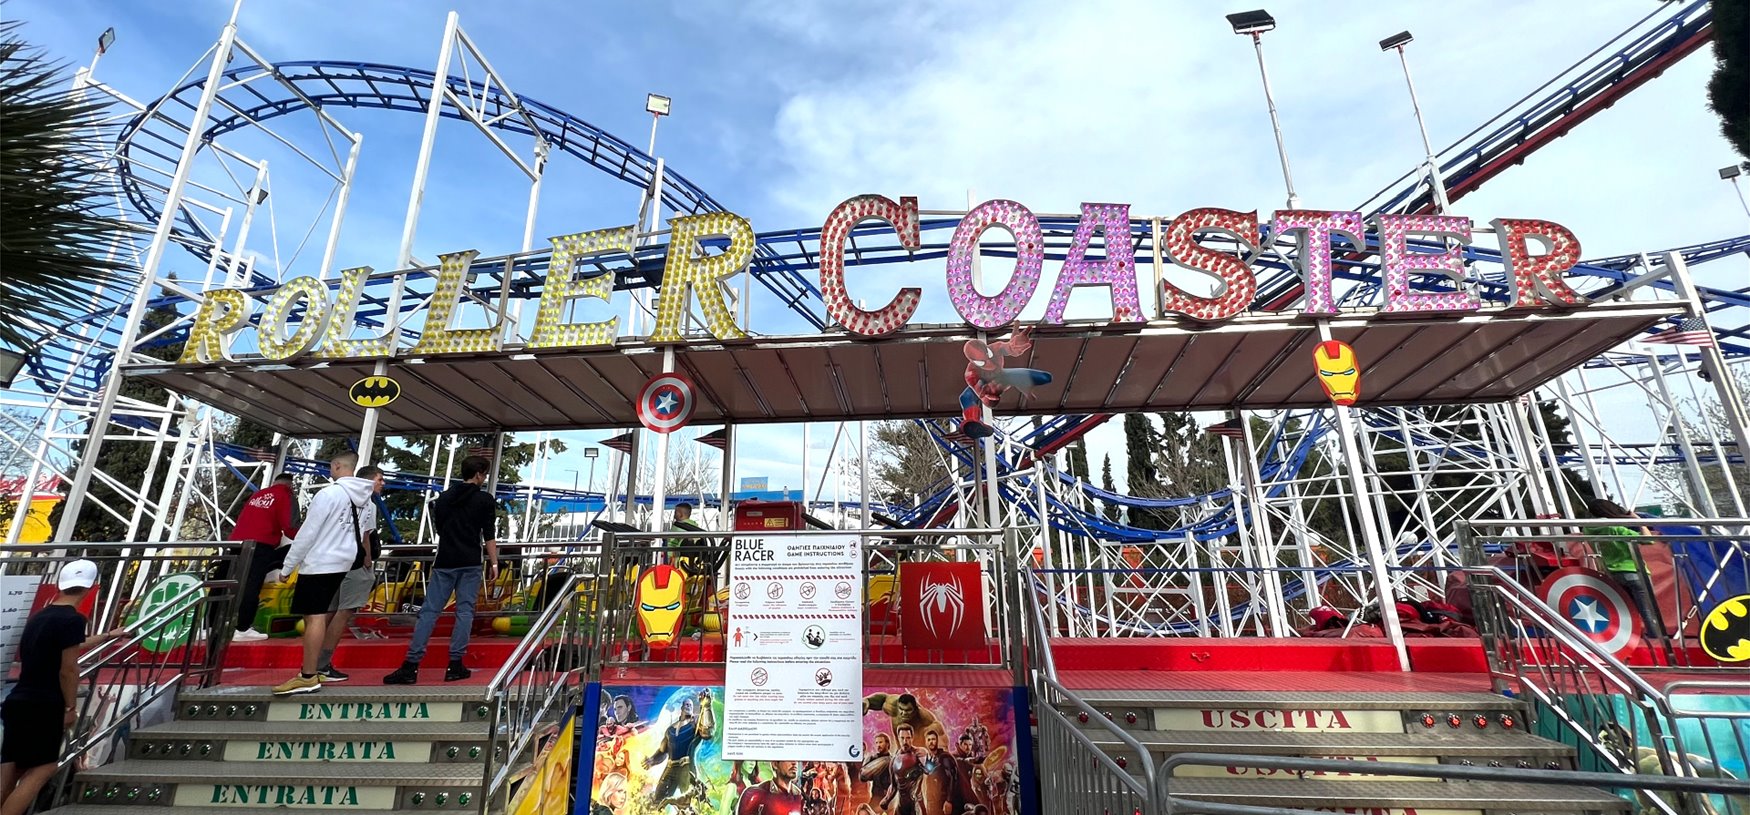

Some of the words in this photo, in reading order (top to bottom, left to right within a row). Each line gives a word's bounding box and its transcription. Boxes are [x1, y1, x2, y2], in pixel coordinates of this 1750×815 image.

[176, 211, 757, 364] ROLLER
[819, 194, 1586, 336] COASTER
[735, 539, 764, 550] BLUE
[735, 550, 774, 561] RACER
[298, 702, 430, 720] ENTRATA
[1200, 708, 1352, 729] USCITA
[256, 741, 396, 760] ENTRATA
[210, 784, 359, 805] ENTRATA
